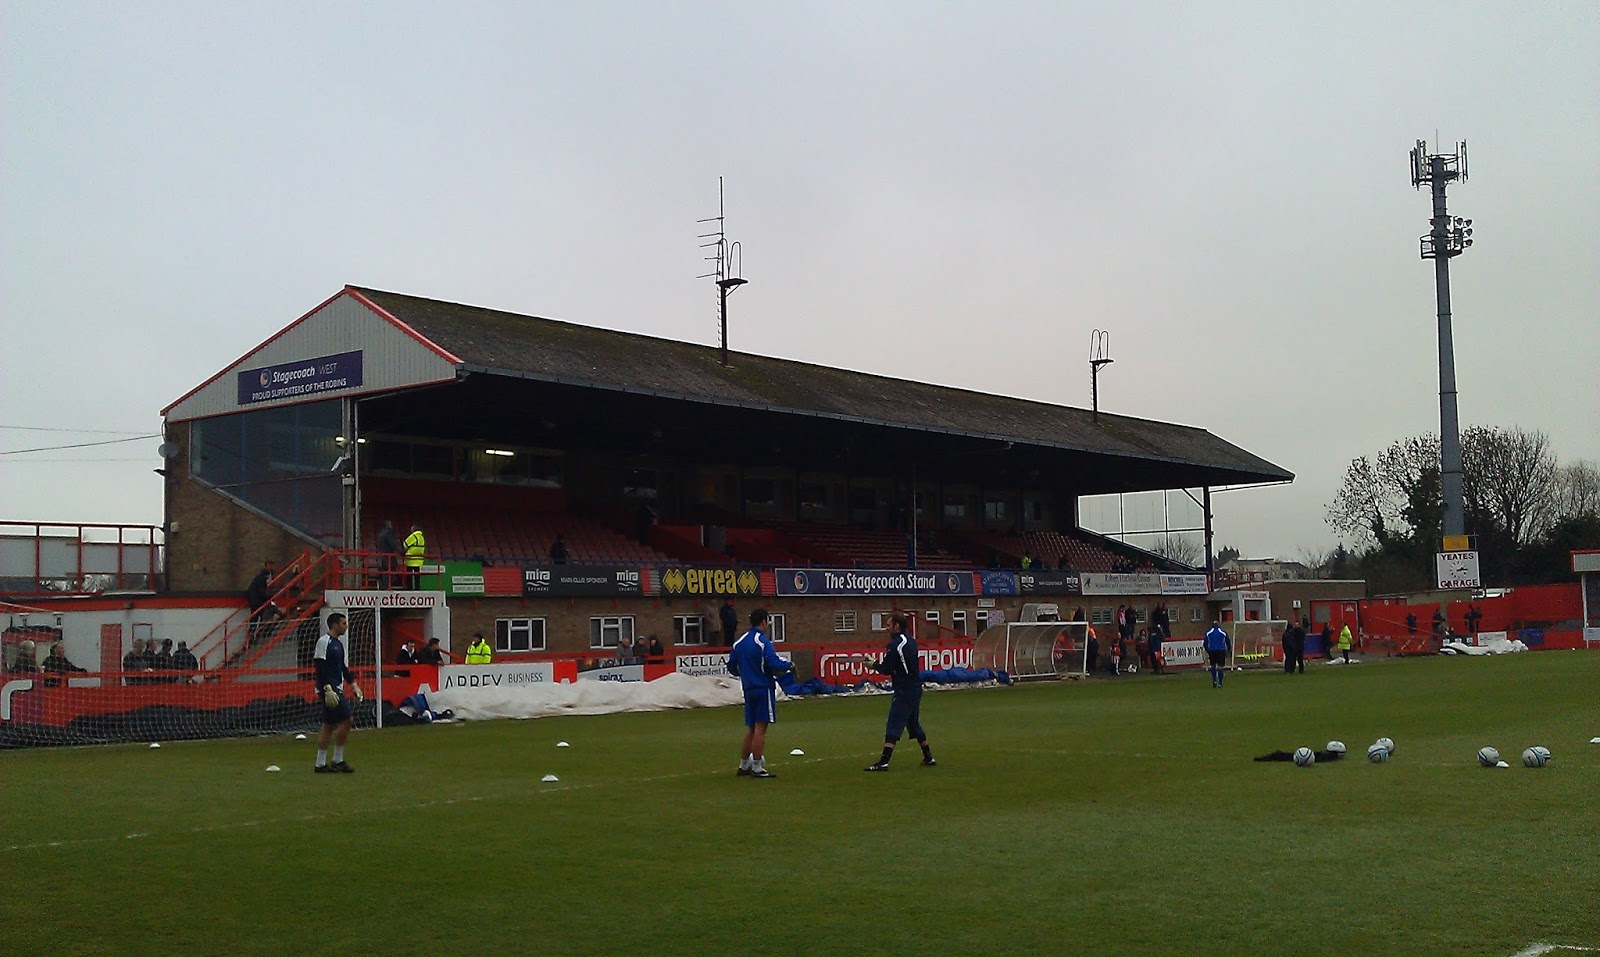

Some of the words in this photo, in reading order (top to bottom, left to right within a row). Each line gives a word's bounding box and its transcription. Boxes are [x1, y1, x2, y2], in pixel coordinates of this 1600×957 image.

[272, 366, 315, 384] Stagecoach
[319, 363, 337, 374] WEST
[252, 392, 271, 400] PROUD
[272, 385, 304, 398] SUPPORTERS
[305, 384, 313, 392] OF
[325, 378, 346, 388] ROBINS
[525, 568, 551, 580] mira
[616, 570, 639, 581] mira
[825, 572, 845, 588] The
[846, 572, 905, 593] Stagecoach
[907, 573, 936, 588] Stand
[1440, 579, 1478, 587] GARAGE
[343, 593, 435, 606] www.ctfc.com
[678, 656, 728, 667] KELLA
[508, 673, 543, 683] BUSINESS
